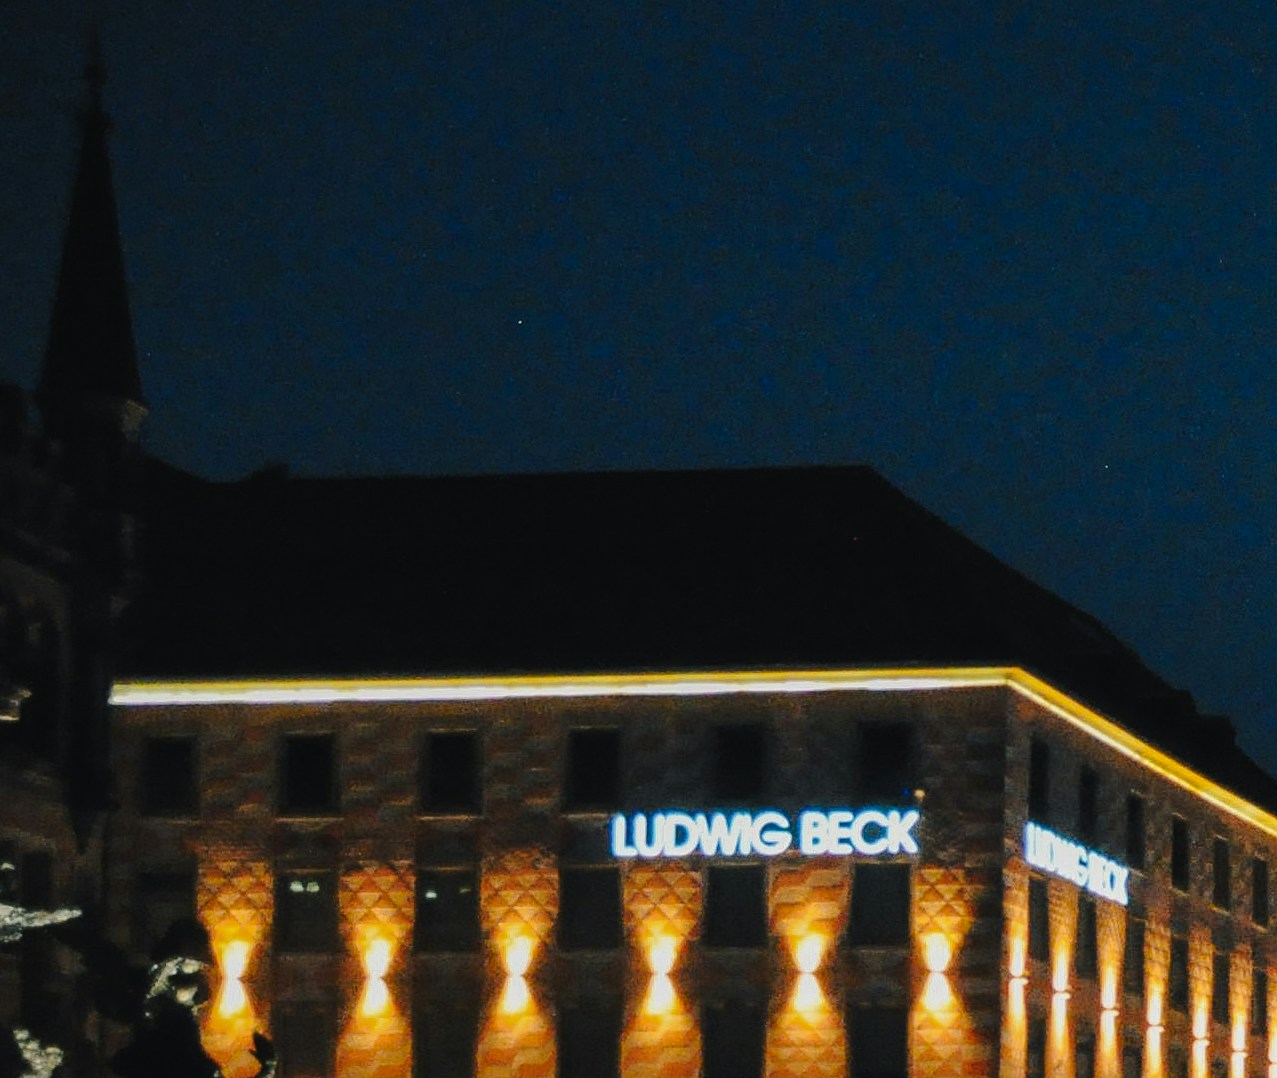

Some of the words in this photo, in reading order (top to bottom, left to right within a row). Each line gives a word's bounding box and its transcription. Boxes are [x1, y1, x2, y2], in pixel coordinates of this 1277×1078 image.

[610, 810, 793, 857] LUDWIG
[800, 808, 919, 856] BECK
[1024, 819, 1088, 889] LUDWIG
[1087, 849, 1130, 906] BECK
